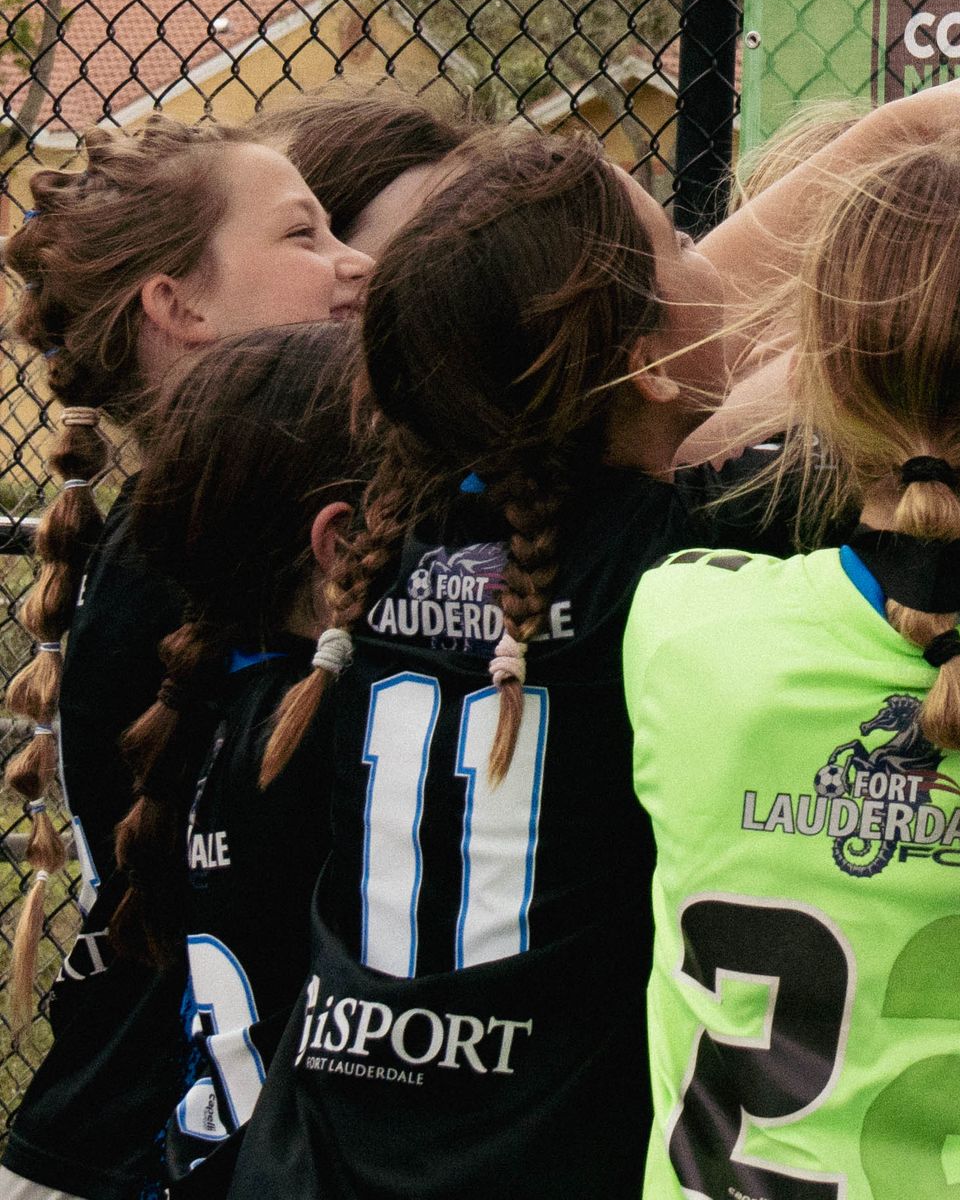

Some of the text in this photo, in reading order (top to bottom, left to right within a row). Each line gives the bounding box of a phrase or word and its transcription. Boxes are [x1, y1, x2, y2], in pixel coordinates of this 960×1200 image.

[435, 574, 489, 602] FORT
[853, 770, 923, 803] FORT
[362, 671, 550, 979] 11
[306, 1056, 424, 1086] FORT LAUDERDALE
